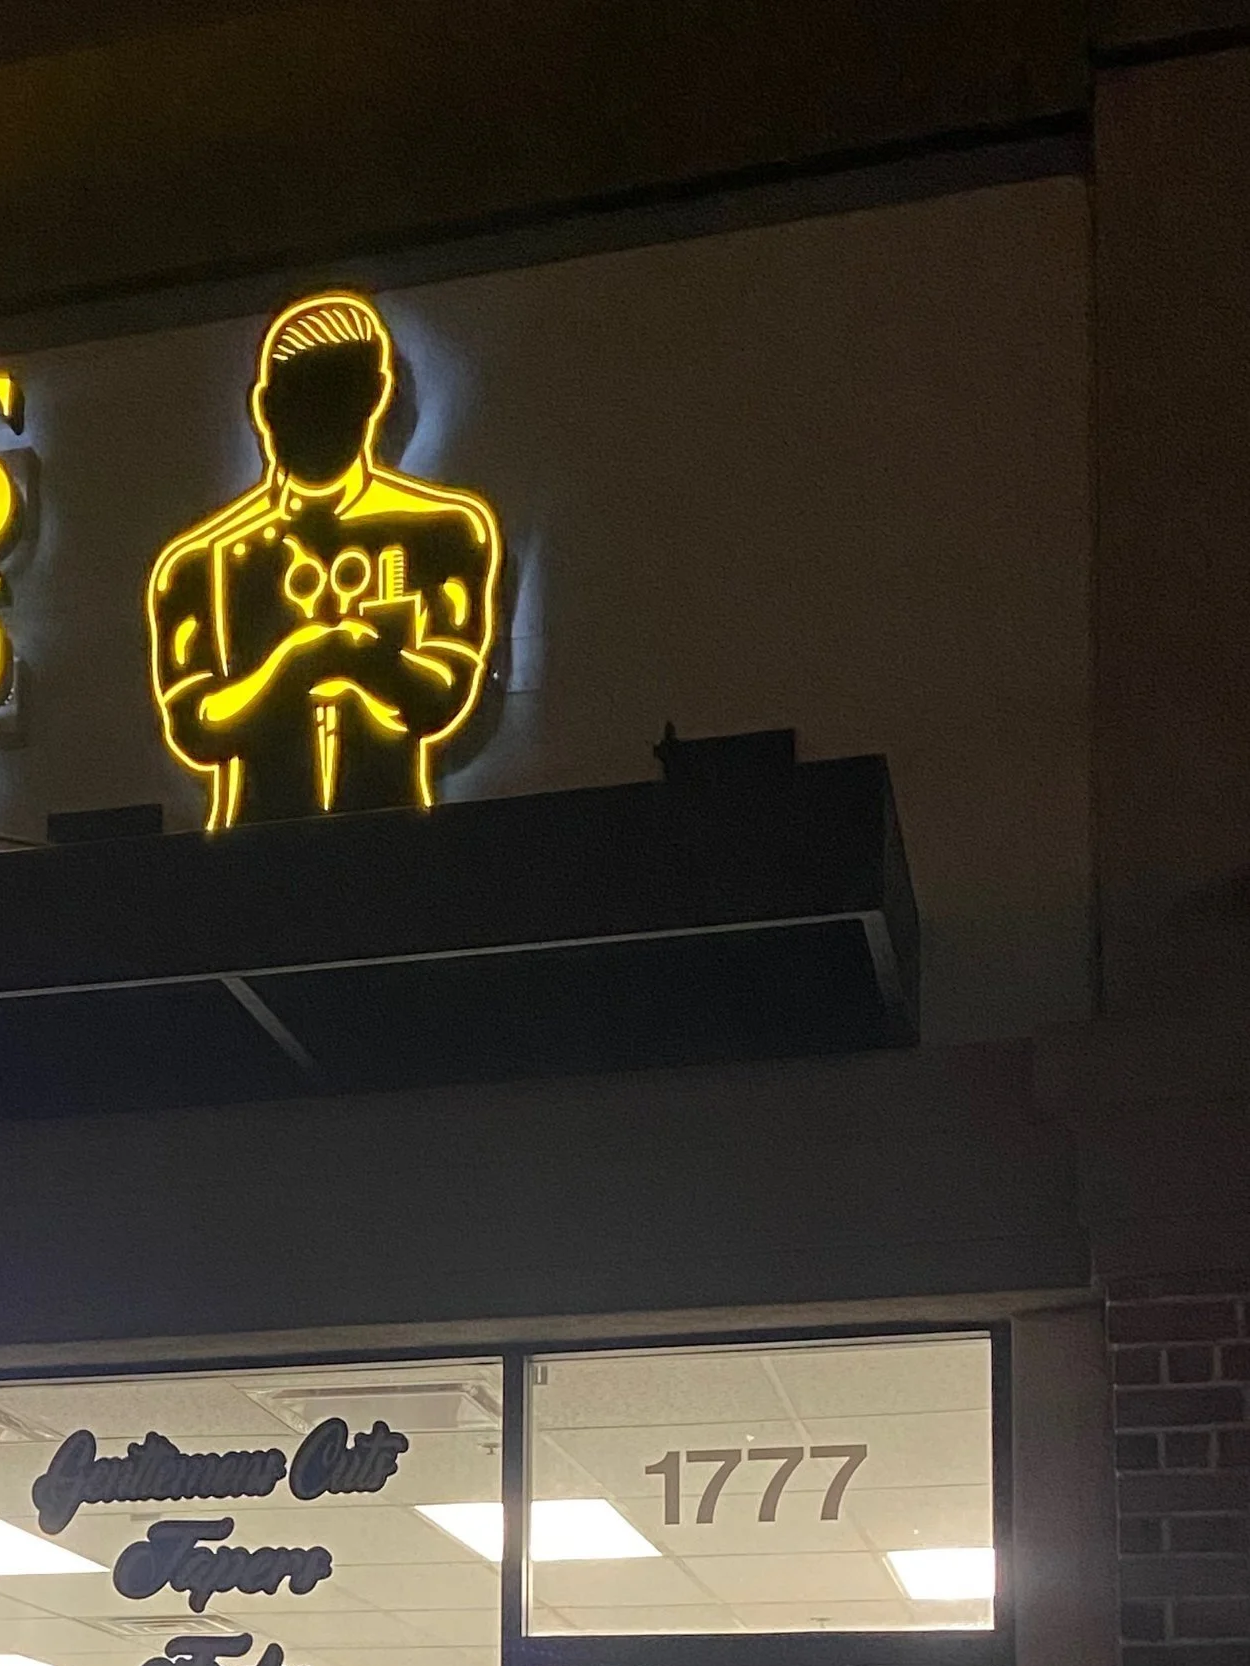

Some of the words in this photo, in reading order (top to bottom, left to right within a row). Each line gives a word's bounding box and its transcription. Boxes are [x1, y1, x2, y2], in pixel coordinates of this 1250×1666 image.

[290, 1418, 408, 1500] Cuts
[645, 1444, 868, 1525] 1777
[113, 1517, 332, 1612] Tapers
